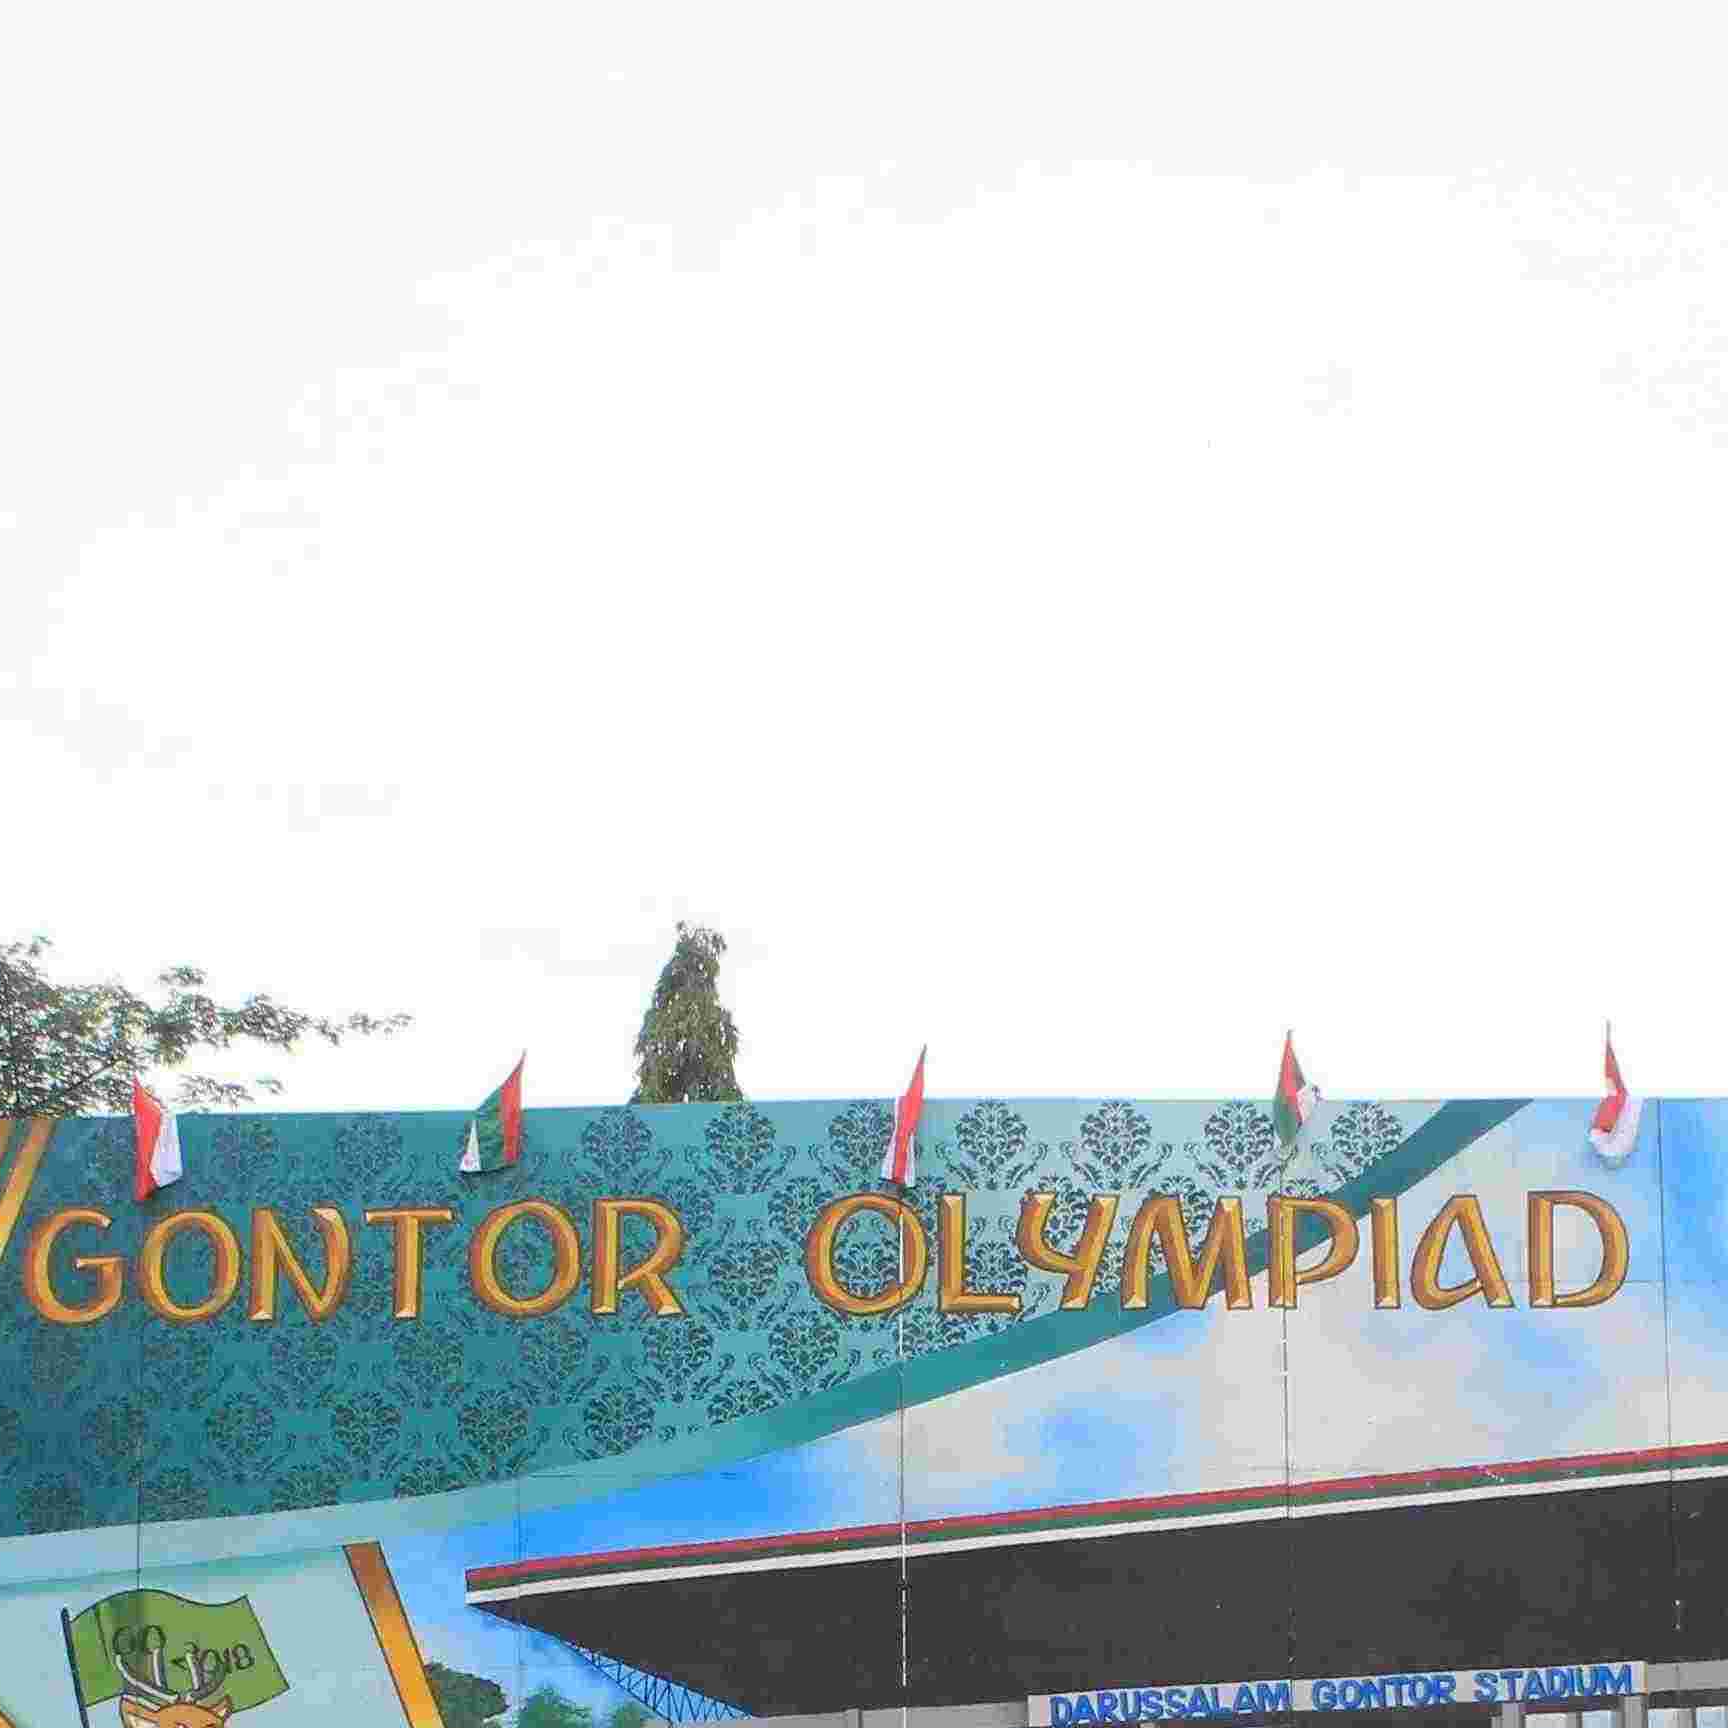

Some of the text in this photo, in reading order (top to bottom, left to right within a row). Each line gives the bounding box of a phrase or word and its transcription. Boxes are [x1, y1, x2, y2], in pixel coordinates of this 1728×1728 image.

[24, 1198, 684, 1324] GONTOR
[803, 1189, 1631, 1318] OLYMPIAD
[1048, 1663, 1633, 1728] DARUSSALAM GONTOR STADIUM
